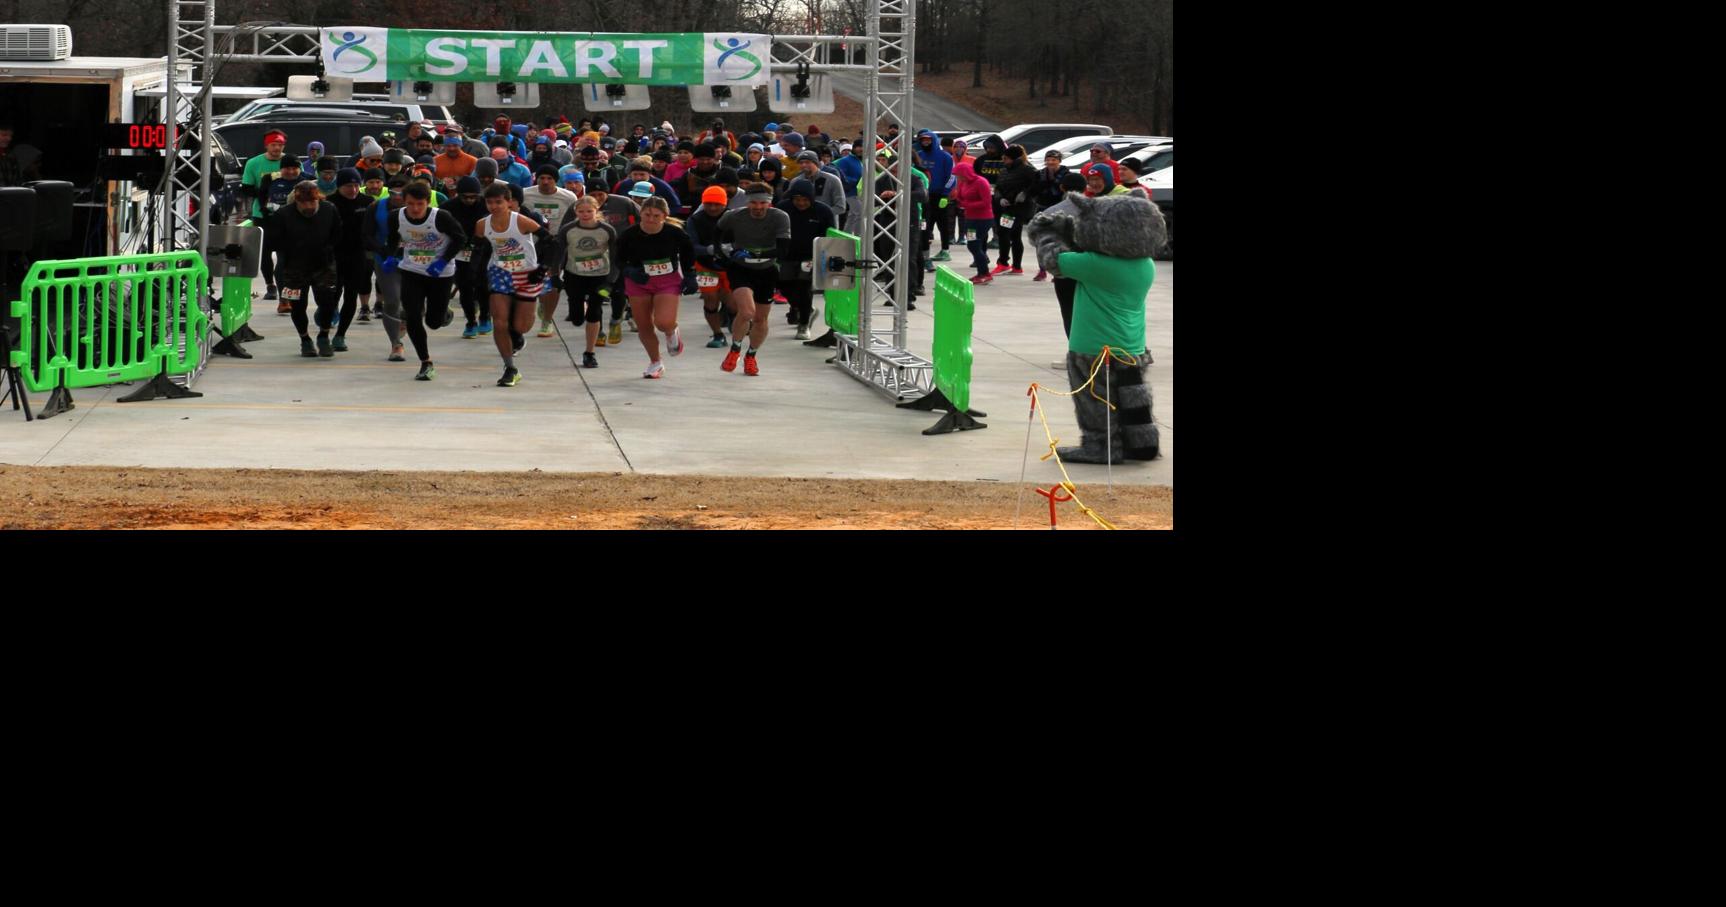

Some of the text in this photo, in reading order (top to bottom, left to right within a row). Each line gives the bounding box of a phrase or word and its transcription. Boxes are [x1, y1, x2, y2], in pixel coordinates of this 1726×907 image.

[424, 37, 668, 79] START
[129, 125, 179, 148] 00:0
[503, 260, 522, 268] 212
[648, 263, 668, 272] 210
